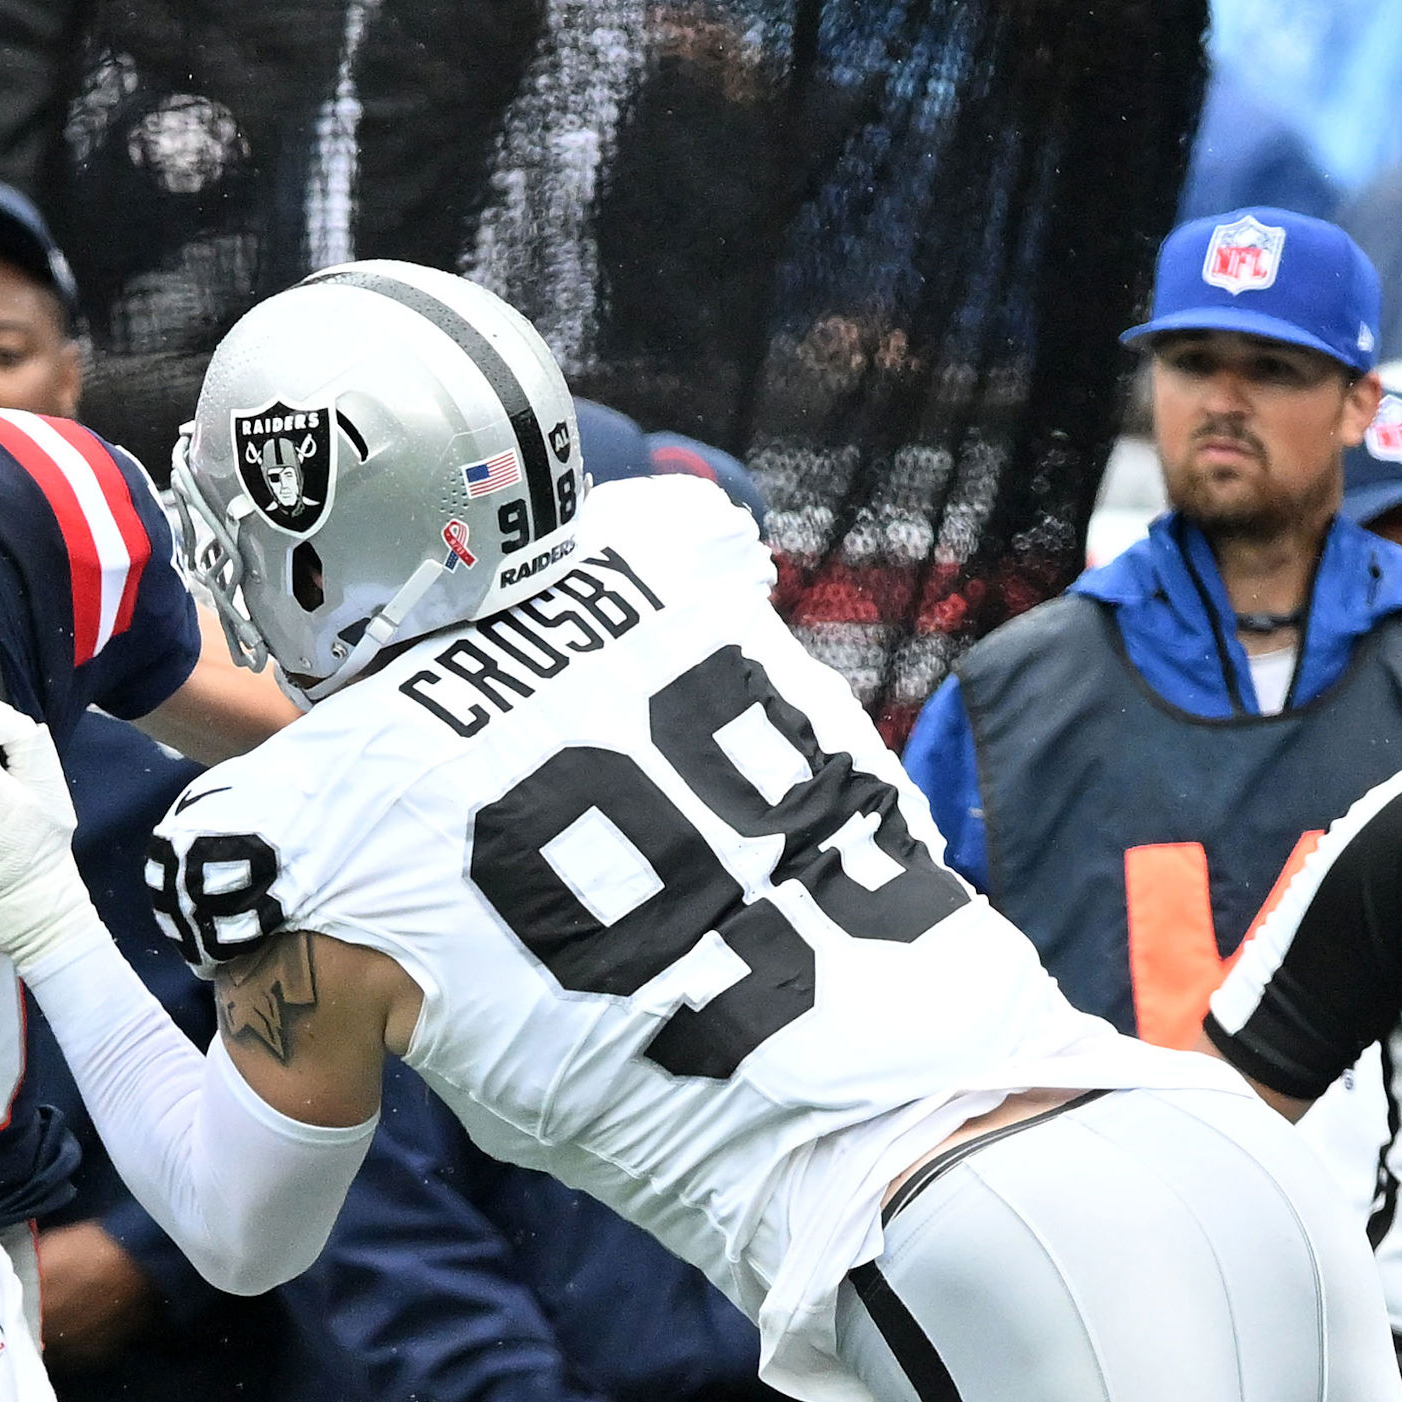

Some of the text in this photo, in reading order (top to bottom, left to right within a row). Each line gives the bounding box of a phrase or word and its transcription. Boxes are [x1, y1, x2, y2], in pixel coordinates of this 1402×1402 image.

[1211, 246, 1268, 279] NFL
[241, 412, 320, 436] RAIDERS
[398, 546, 666, 738] CROSBY
[470, 643, 972, 1080] 98
